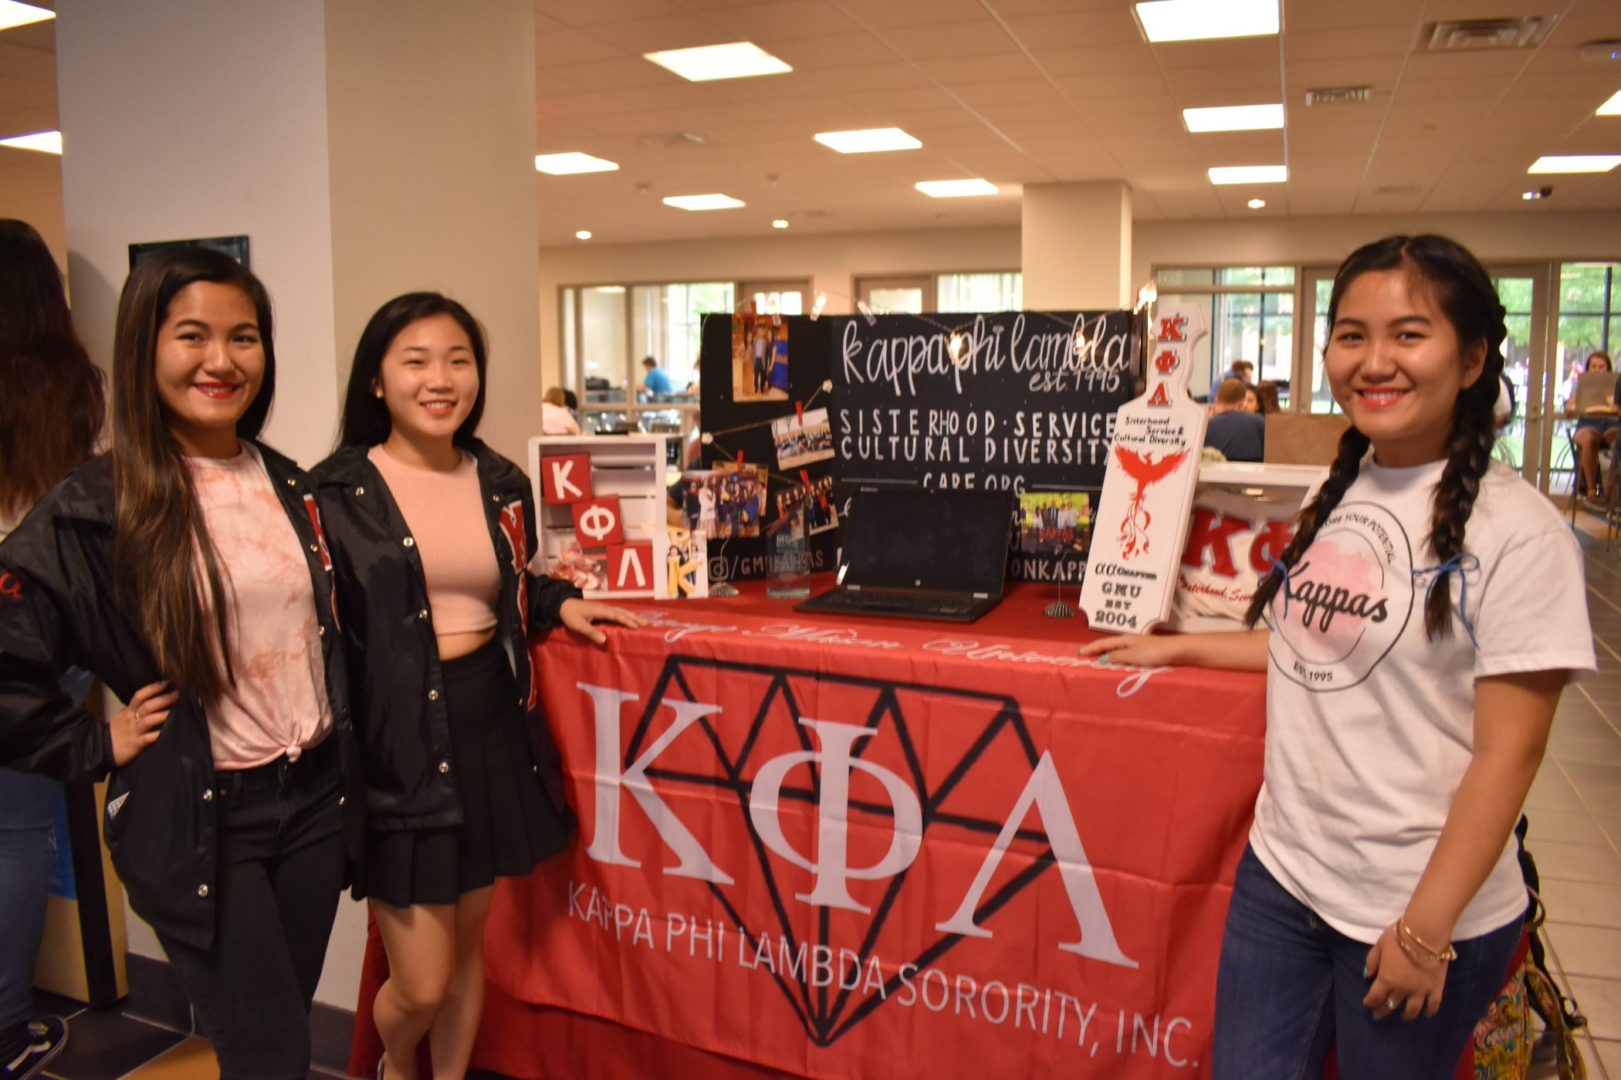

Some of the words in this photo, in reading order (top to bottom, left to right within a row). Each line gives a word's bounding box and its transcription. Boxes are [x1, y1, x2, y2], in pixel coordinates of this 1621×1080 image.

[842, 319, 949, 396] kappa
[951, 314, 1006, 394] phi
[1010, 312, 1130, 374] lambda
[1068, 369, 1120, 393] 1995
[840, 409, 995, 437] SISTERHOOD
[1013, 411, 1118, 439] SERVICE
[841, 436, 970, 462] CULTURAL
[984, 437, 1112, 466] DIVERSITY
[1101, 582, 1142, 598] GMU
[1105, 600, 1132, 610] EST
[1094, 610, 1137, 629] 2004
[1309, 671, 1333, 682] 1995
[568, 880, 654, 949] KAPPA
[667, 912, 724, 962] PHI
[738, 926, 886, 1001] LAMBDA
[897, 962, 1099, 1058] SORORITY,
[1116, 1009, 1199, 1069] INC.
